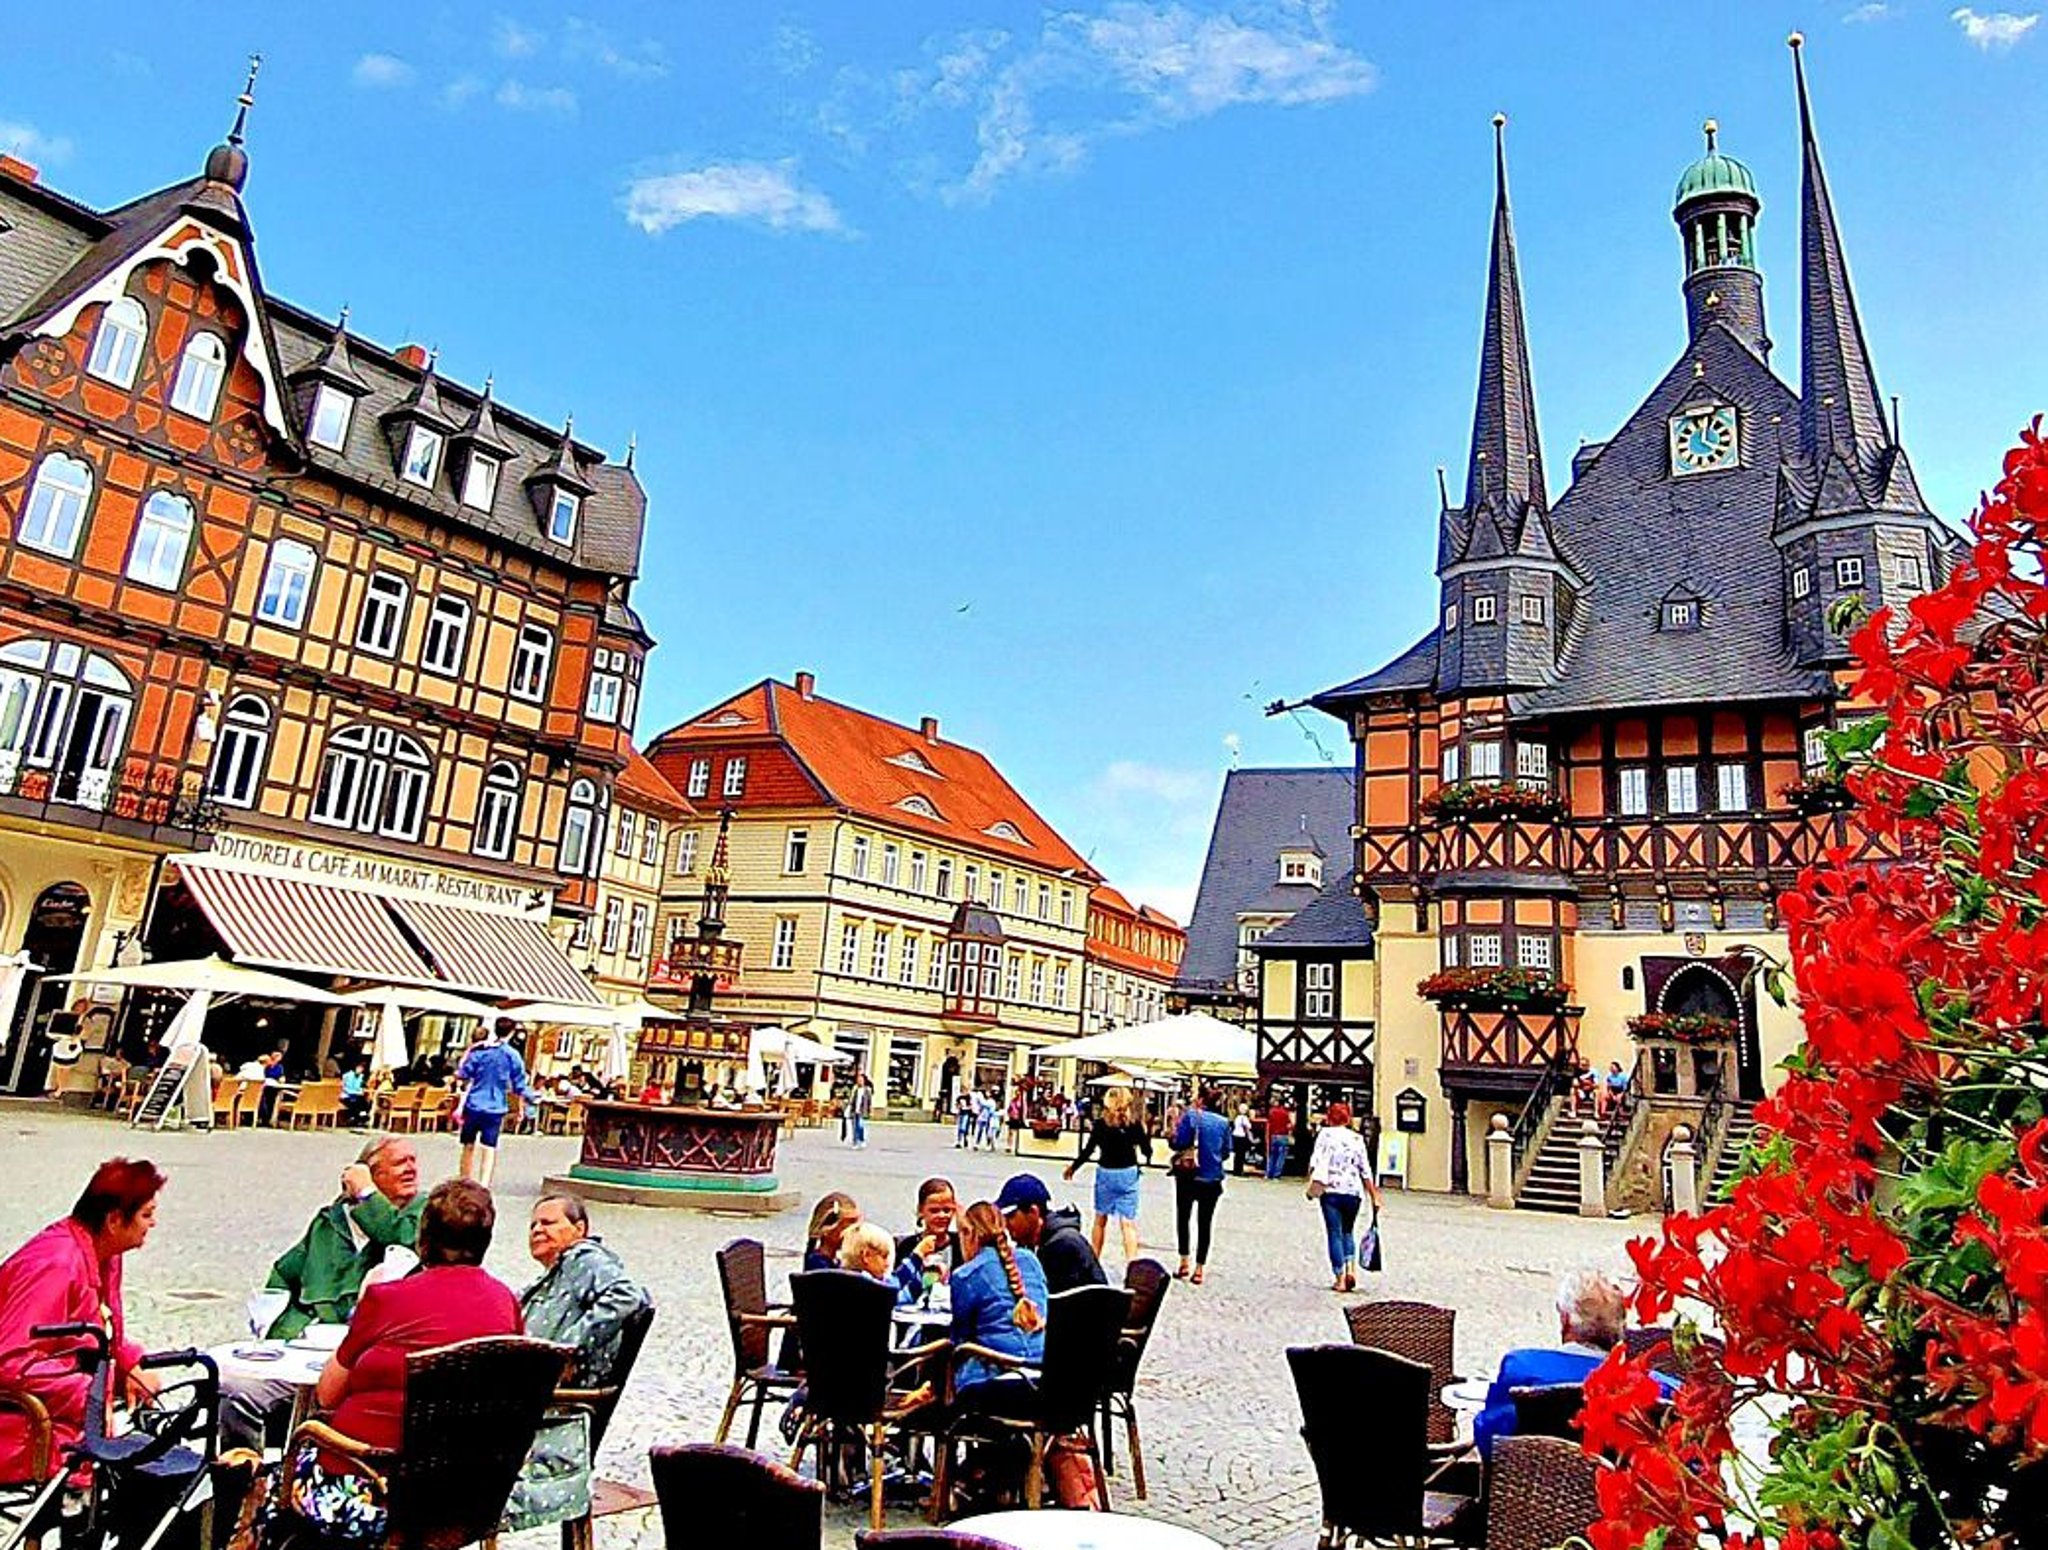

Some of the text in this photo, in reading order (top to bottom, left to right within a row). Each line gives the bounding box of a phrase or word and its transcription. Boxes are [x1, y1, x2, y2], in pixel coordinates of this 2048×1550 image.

[292, 848, 304, 869] &
[308, 850, 350, 877] CAFÉ
[351, 860, 377, 882] AM
[378, 864, 431, 890] MARKT
[436, 872, 522, 907] RESTAURANT
